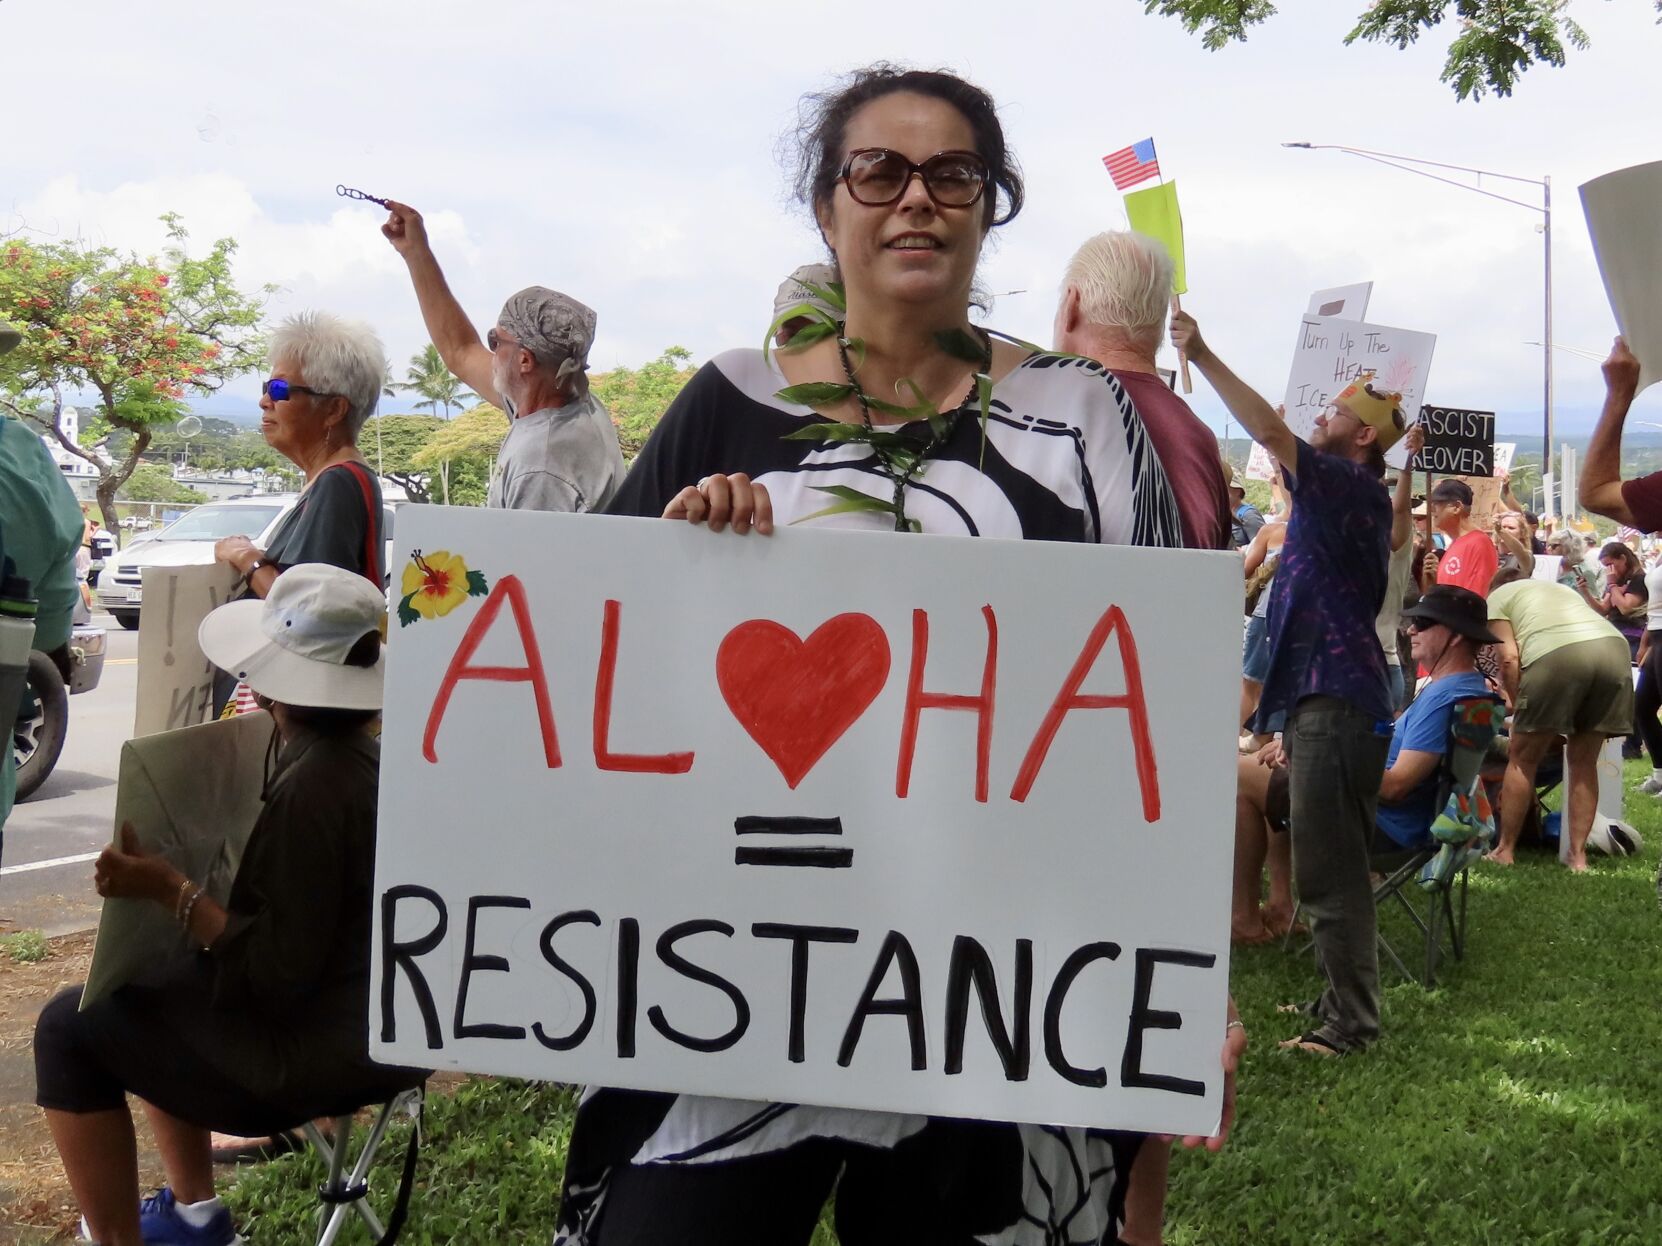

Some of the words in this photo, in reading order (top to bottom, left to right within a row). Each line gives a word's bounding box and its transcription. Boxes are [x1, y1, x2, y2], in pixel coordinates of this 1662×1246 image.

[1302, 320, 1329, 350] Turn
[1339, 332, 1354, 356] Up
[1364, 332, 1391, 353] The
[1295, 383, 1328, 408] ICE
[1419, 408, 1495, 441] ASCIST
[1412, 445, 1488, 475] KEOVER
[380, 884, 1217, 1097] RESISTANCE
